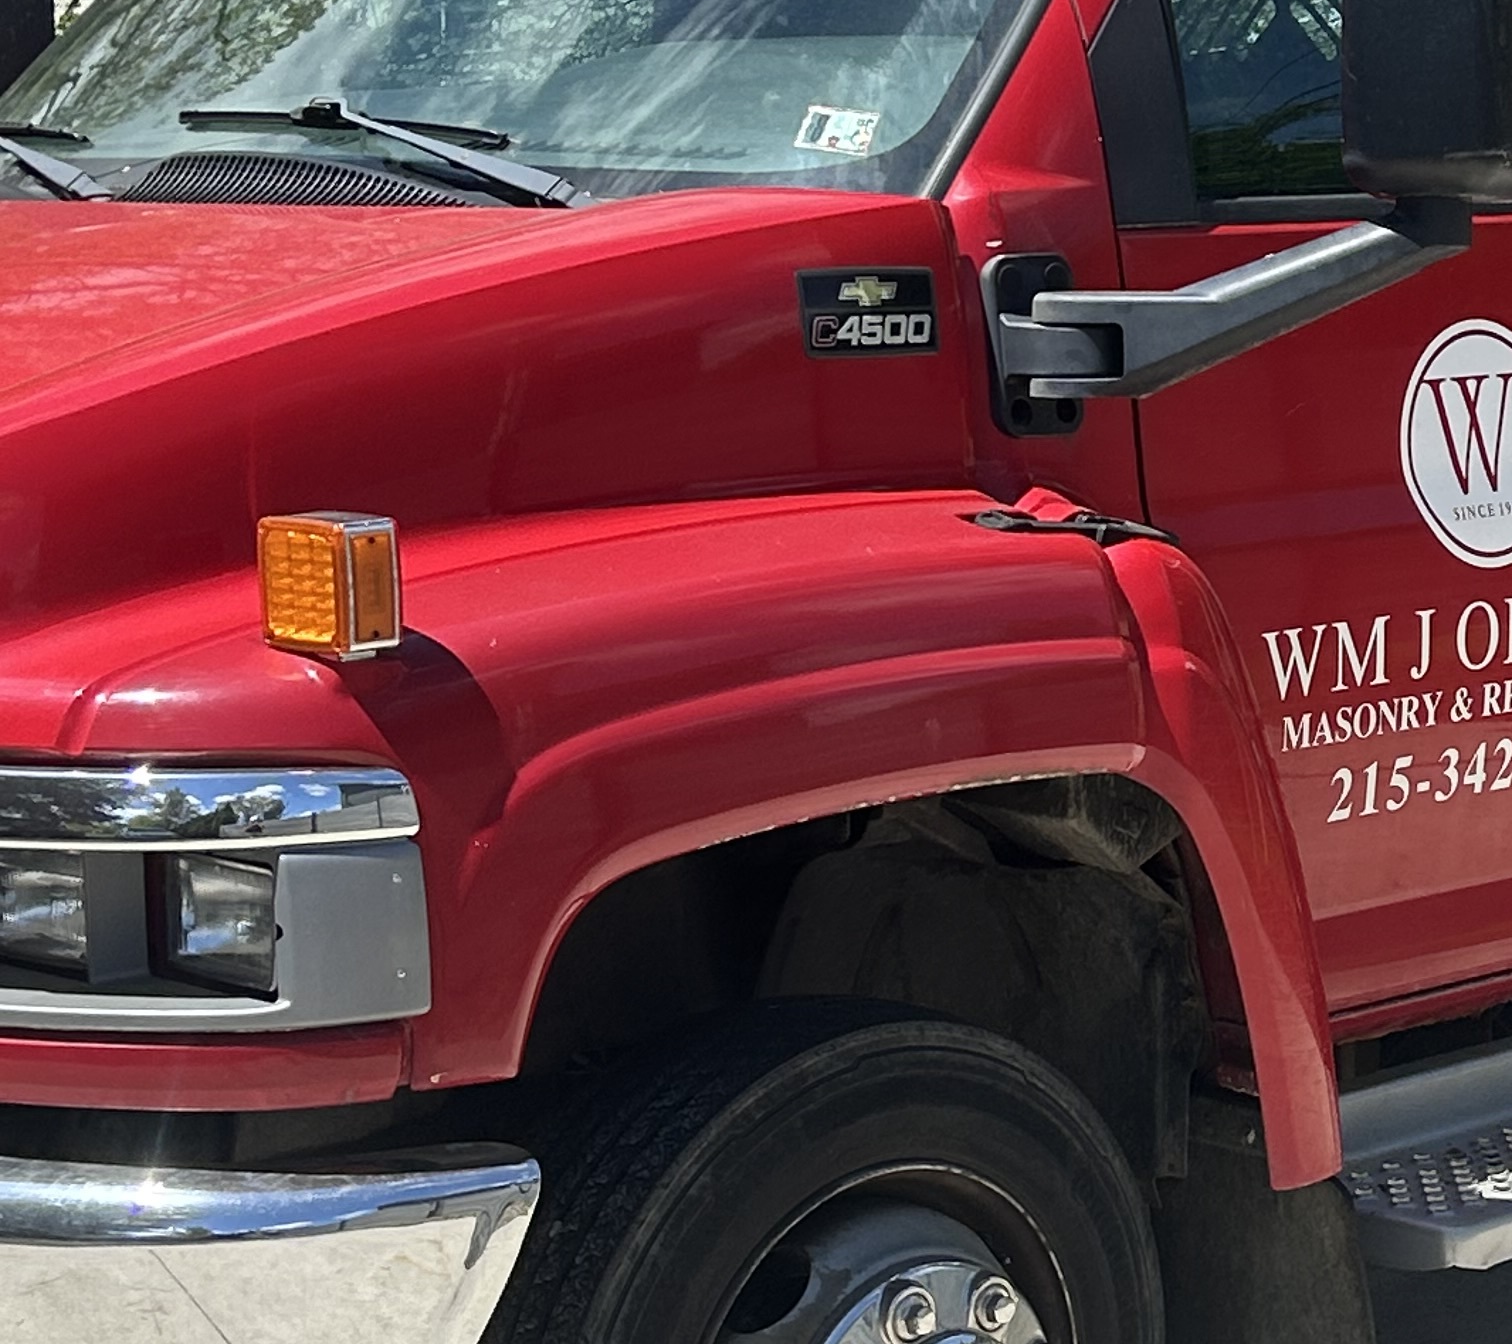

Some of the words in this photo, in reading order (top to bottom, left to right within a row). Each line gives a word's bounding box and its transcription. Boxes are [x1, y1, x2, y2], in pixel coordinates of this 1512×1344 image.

[812, 314, 932, 347] C4500
[1452, 503, 1496, 521] SINCE
[1262, 615, 1391, 701] WM
[1410, 608, 1436, 680] J
[1281, 689, 1442, 752] MASONRY
[1450, 687, 1473, 723] &
